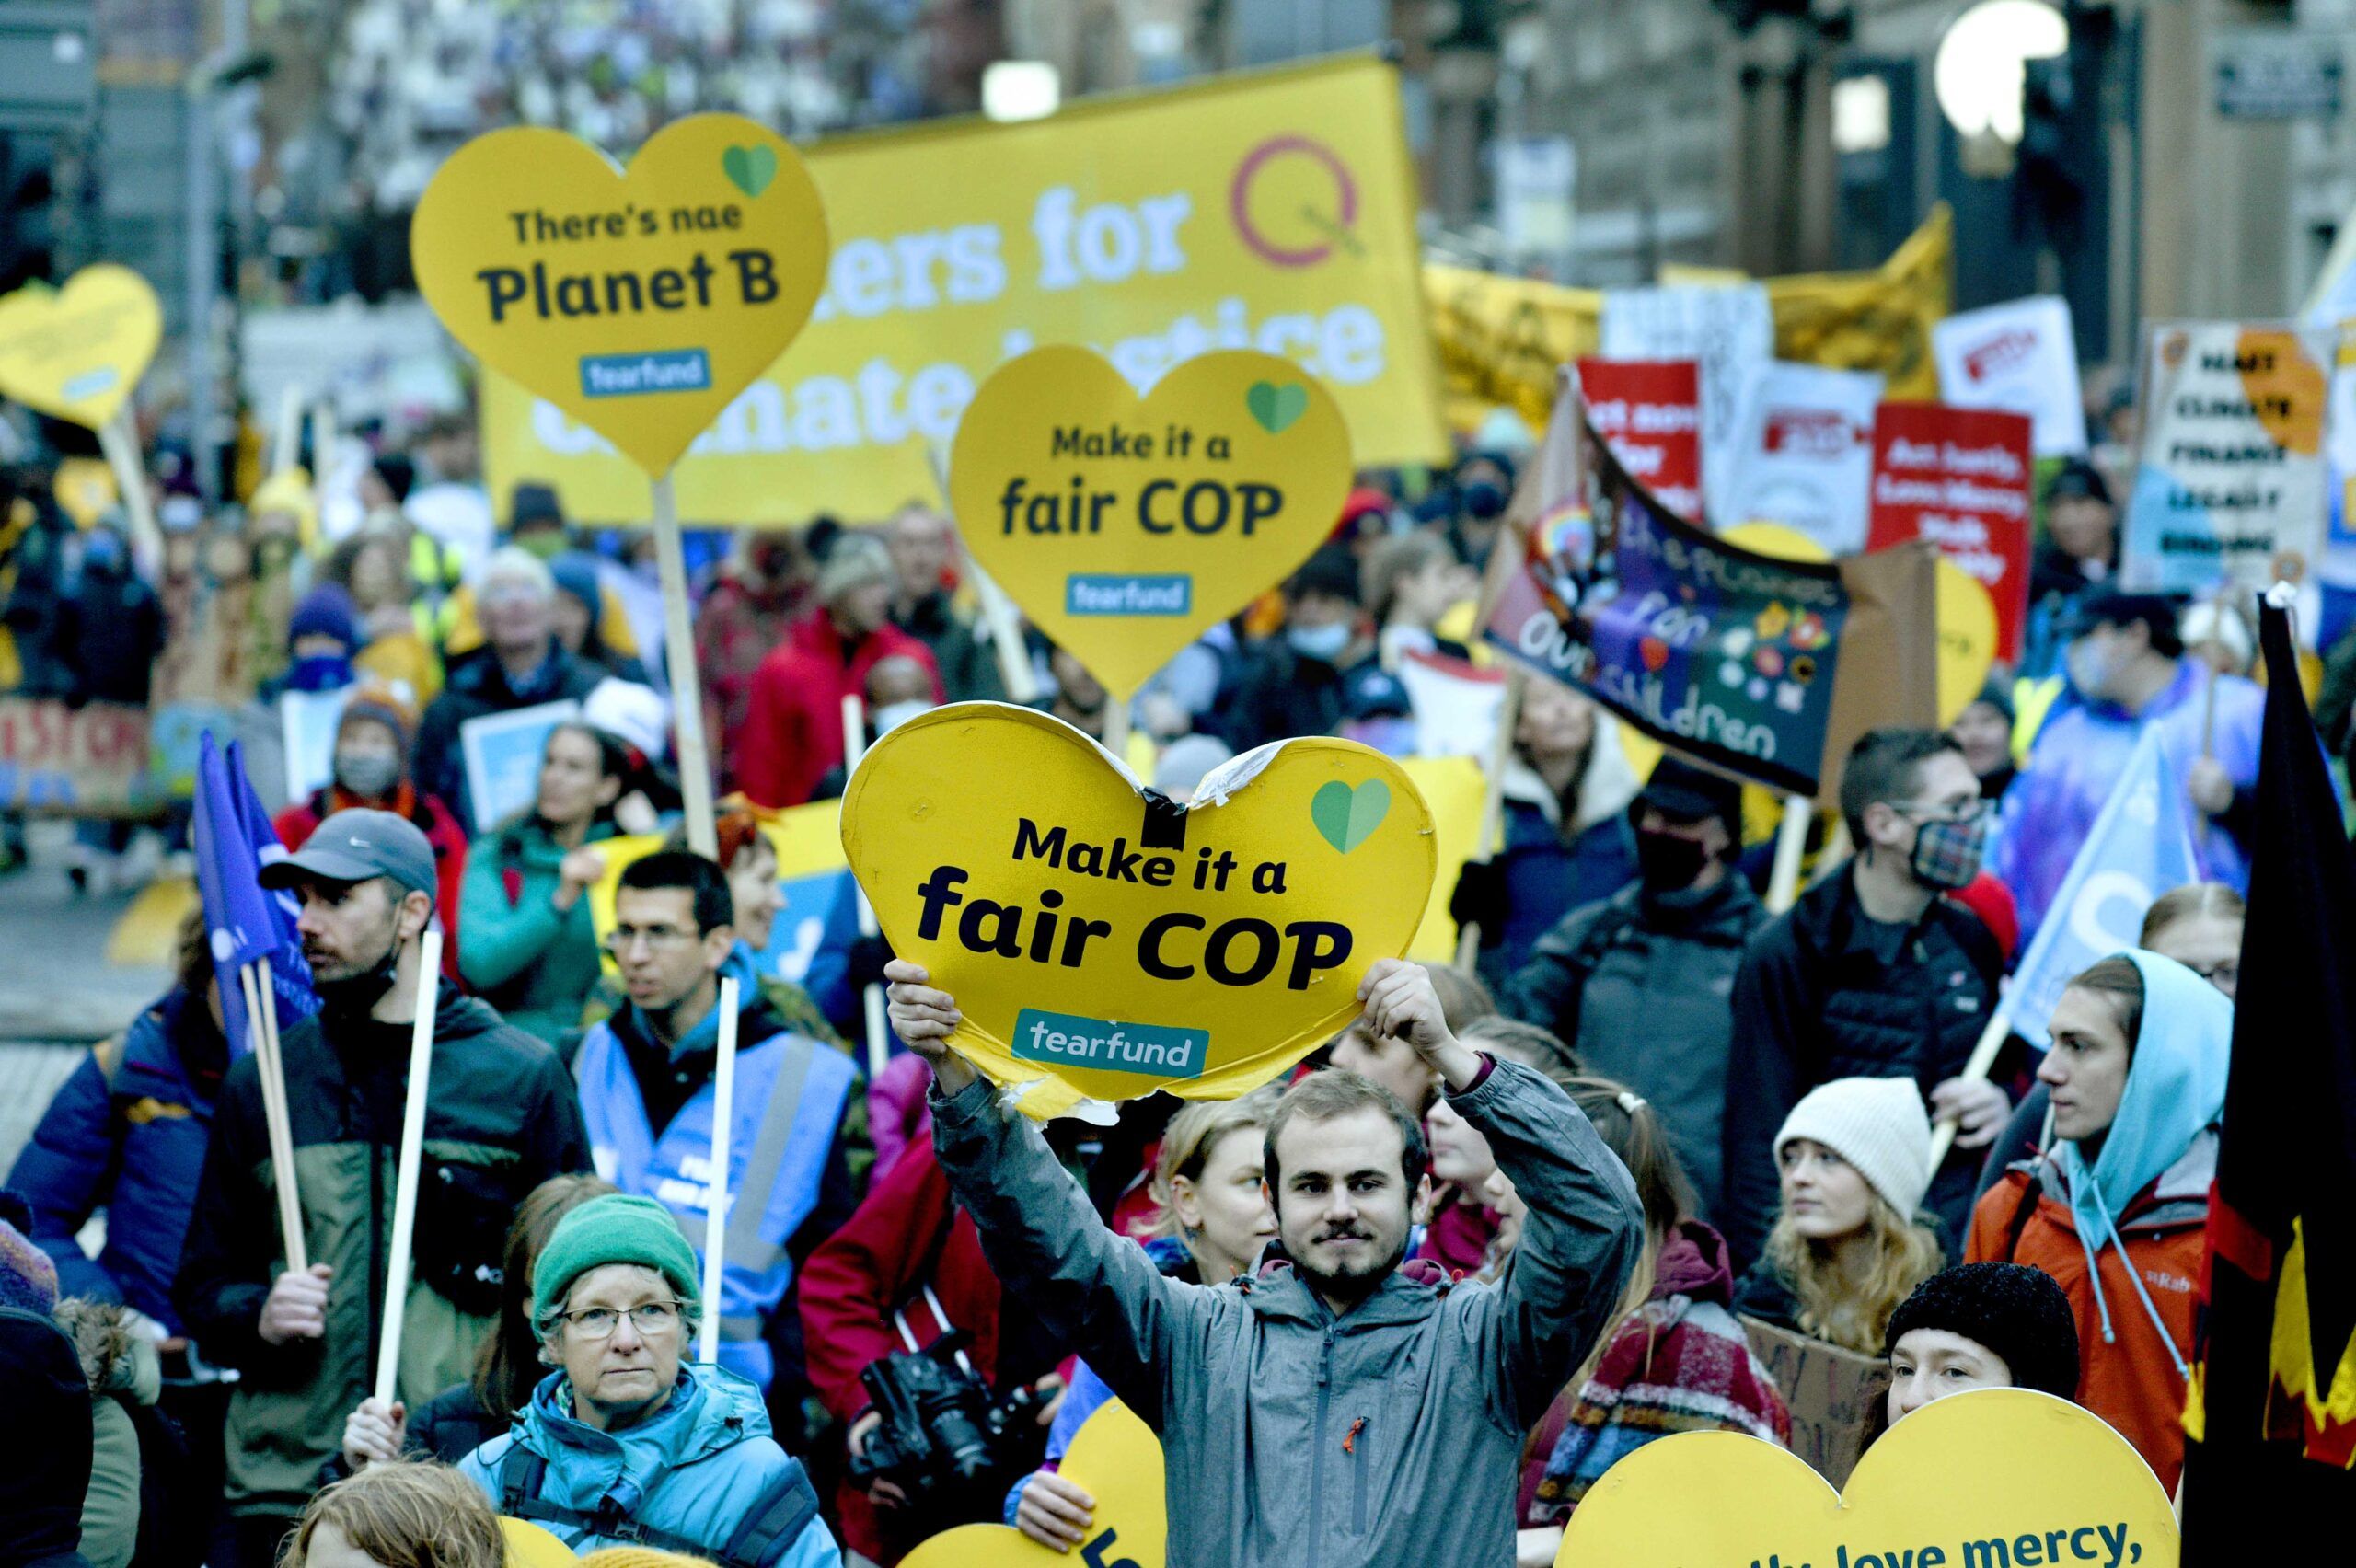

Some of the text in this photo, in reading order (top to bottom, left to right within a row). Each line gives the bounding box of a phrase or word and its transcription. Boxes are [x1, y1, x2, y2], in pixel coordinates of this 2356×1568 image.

[510, 203, 742, 244] There's nae
[1031, 185, 1193, 290] for
[474, 248, 780, 324] Planet B
[587, 352, 703, 391] tearfund
[1052, 424, 1231, 461] Make it a
[999, 474, 1284, 536] fair COP
[1072, 578, 1185, 611] tearfund
[1012, 817, 1288, 894] Make it a
[917, 865, 1354, 991] fair COP
[1029, 1020, 1193, 1068] tearfund
[1962, 1522, 2142, 1568] mercy,
